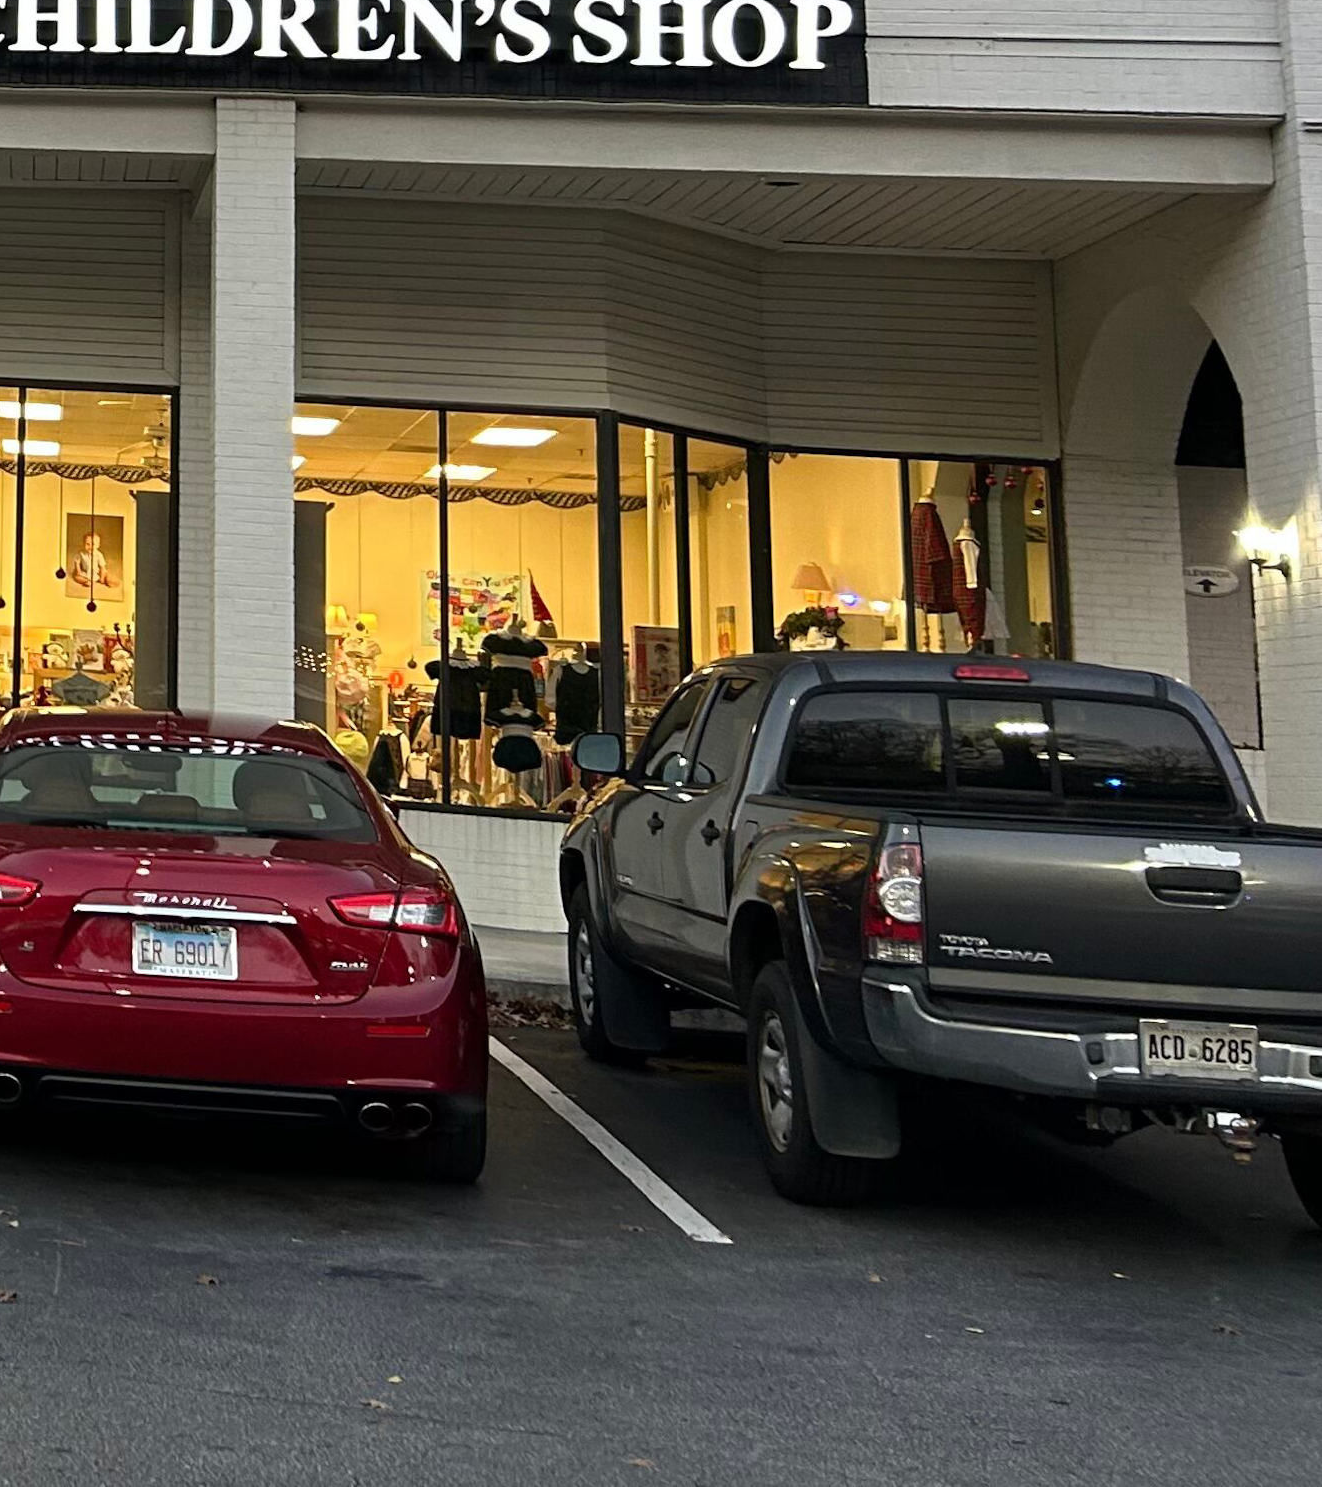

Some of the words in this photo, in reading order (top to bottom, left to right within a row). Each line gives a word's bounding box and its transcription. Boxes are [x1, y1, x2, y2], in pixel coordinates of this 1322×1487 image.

[939, 933, 989, 946] TOYOTA
[141, 938, 162, 965] ER
[174, 940, 229, 968] 69017
[939, 945, 1054, 964] TACOMA
[1149, 1034, 1185, 1060] ACD
[1202, 1037, 1253, 1065] 6285
